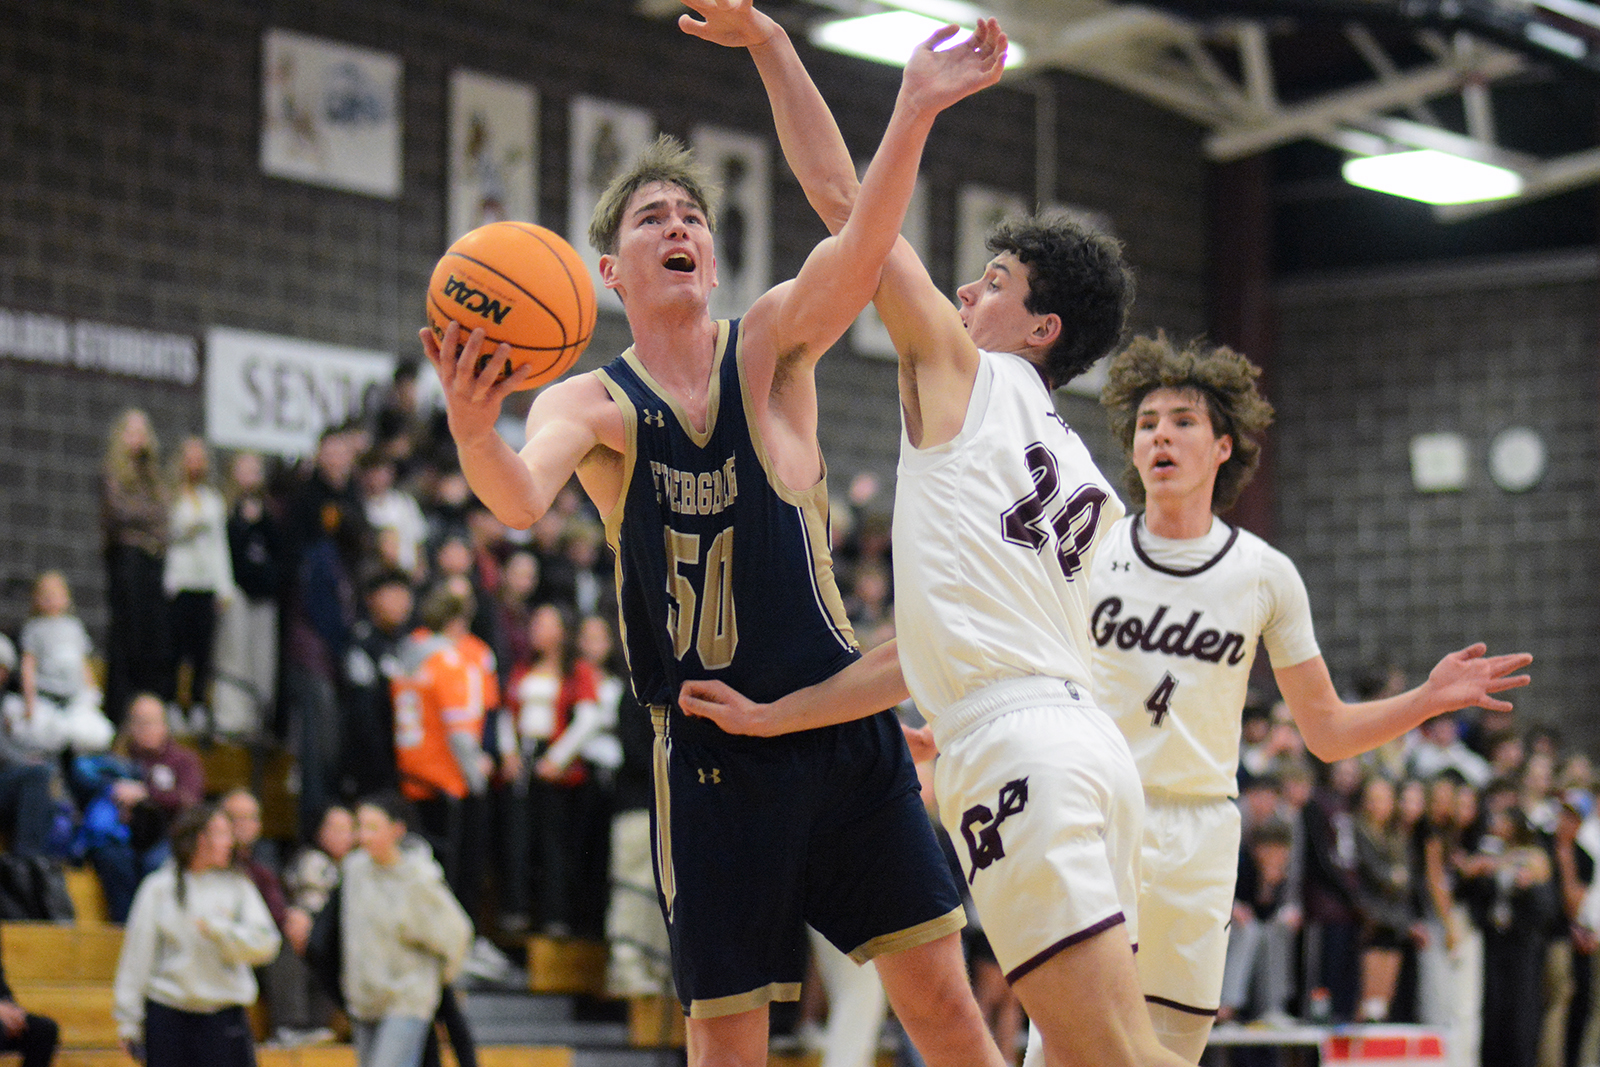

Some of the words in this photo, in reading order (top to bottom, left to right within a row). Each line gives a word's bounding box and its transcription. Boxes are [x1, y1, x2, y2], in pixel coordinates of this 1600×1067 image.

[443, 274, 512, 325] NCAA
[1000, 441, 1110, 582] 20
[664, 525, 739, 670] 50
[1091, 595, 1246, 666] Golden
[1143, 669, 1180, 728] 4
